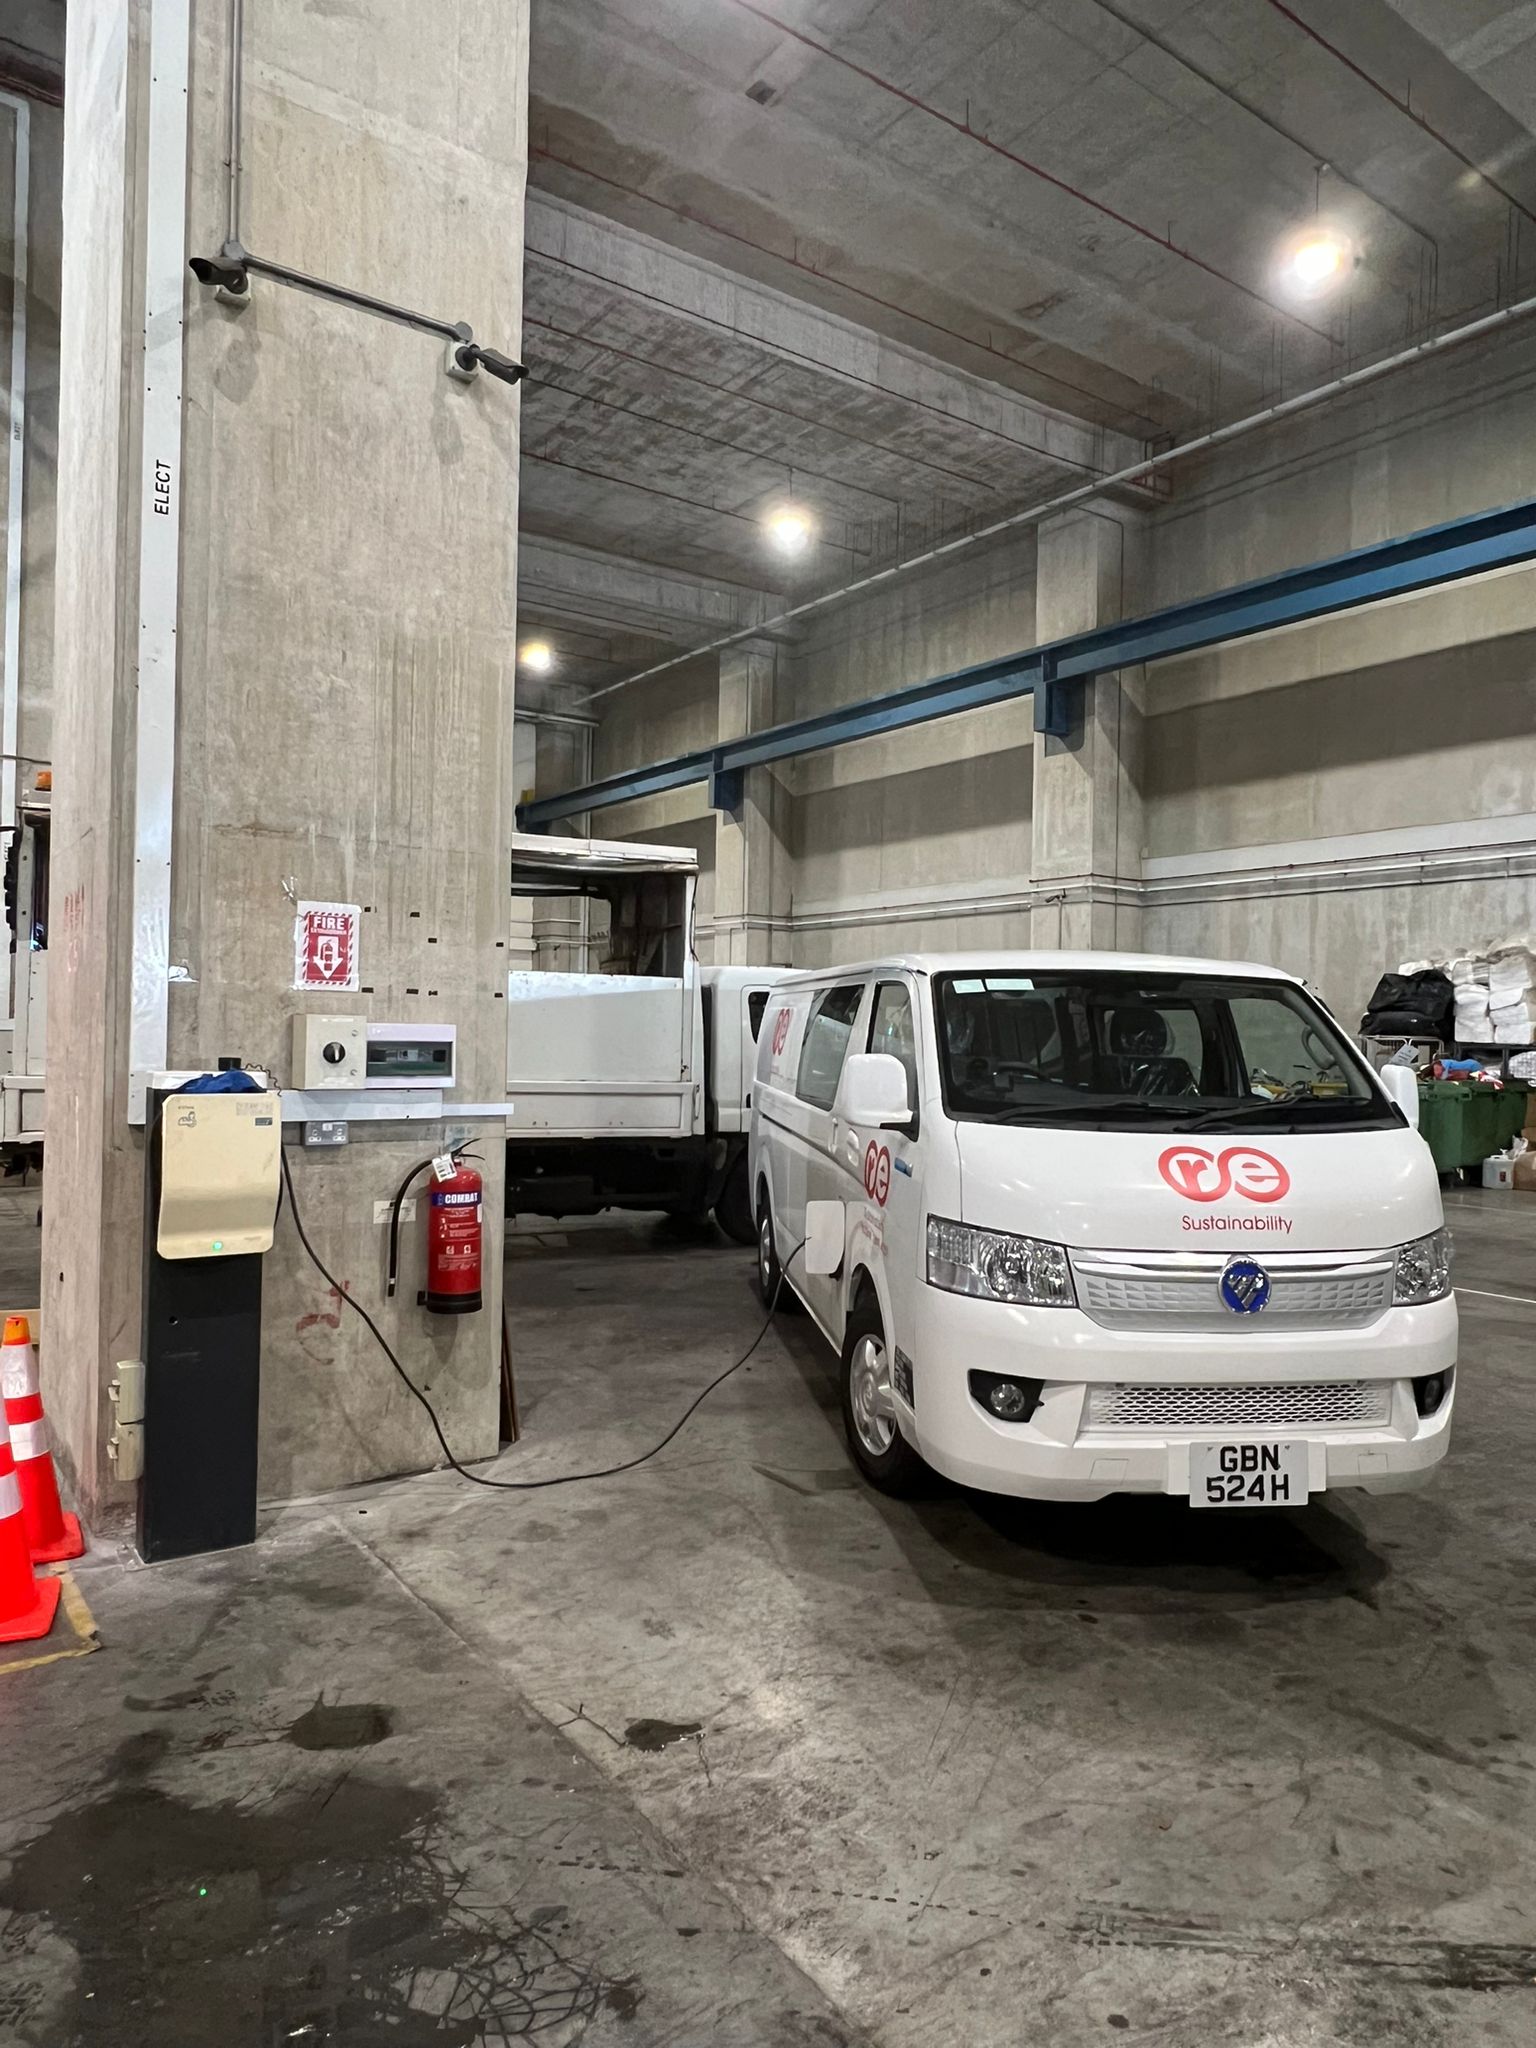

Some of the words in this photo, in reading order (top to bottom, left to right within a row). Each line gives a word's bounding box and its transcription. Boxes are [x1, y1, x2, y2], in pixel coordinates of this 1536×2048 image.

[154, 459, 171, 515] ELECT
[313, 916, 345, 930] FIRE
[444, 1192, 478, 1205] COMBAT
[1182, 1215, 1293, 1234] Sustainability
[1220, 1444, 1279, 1472] GBN
